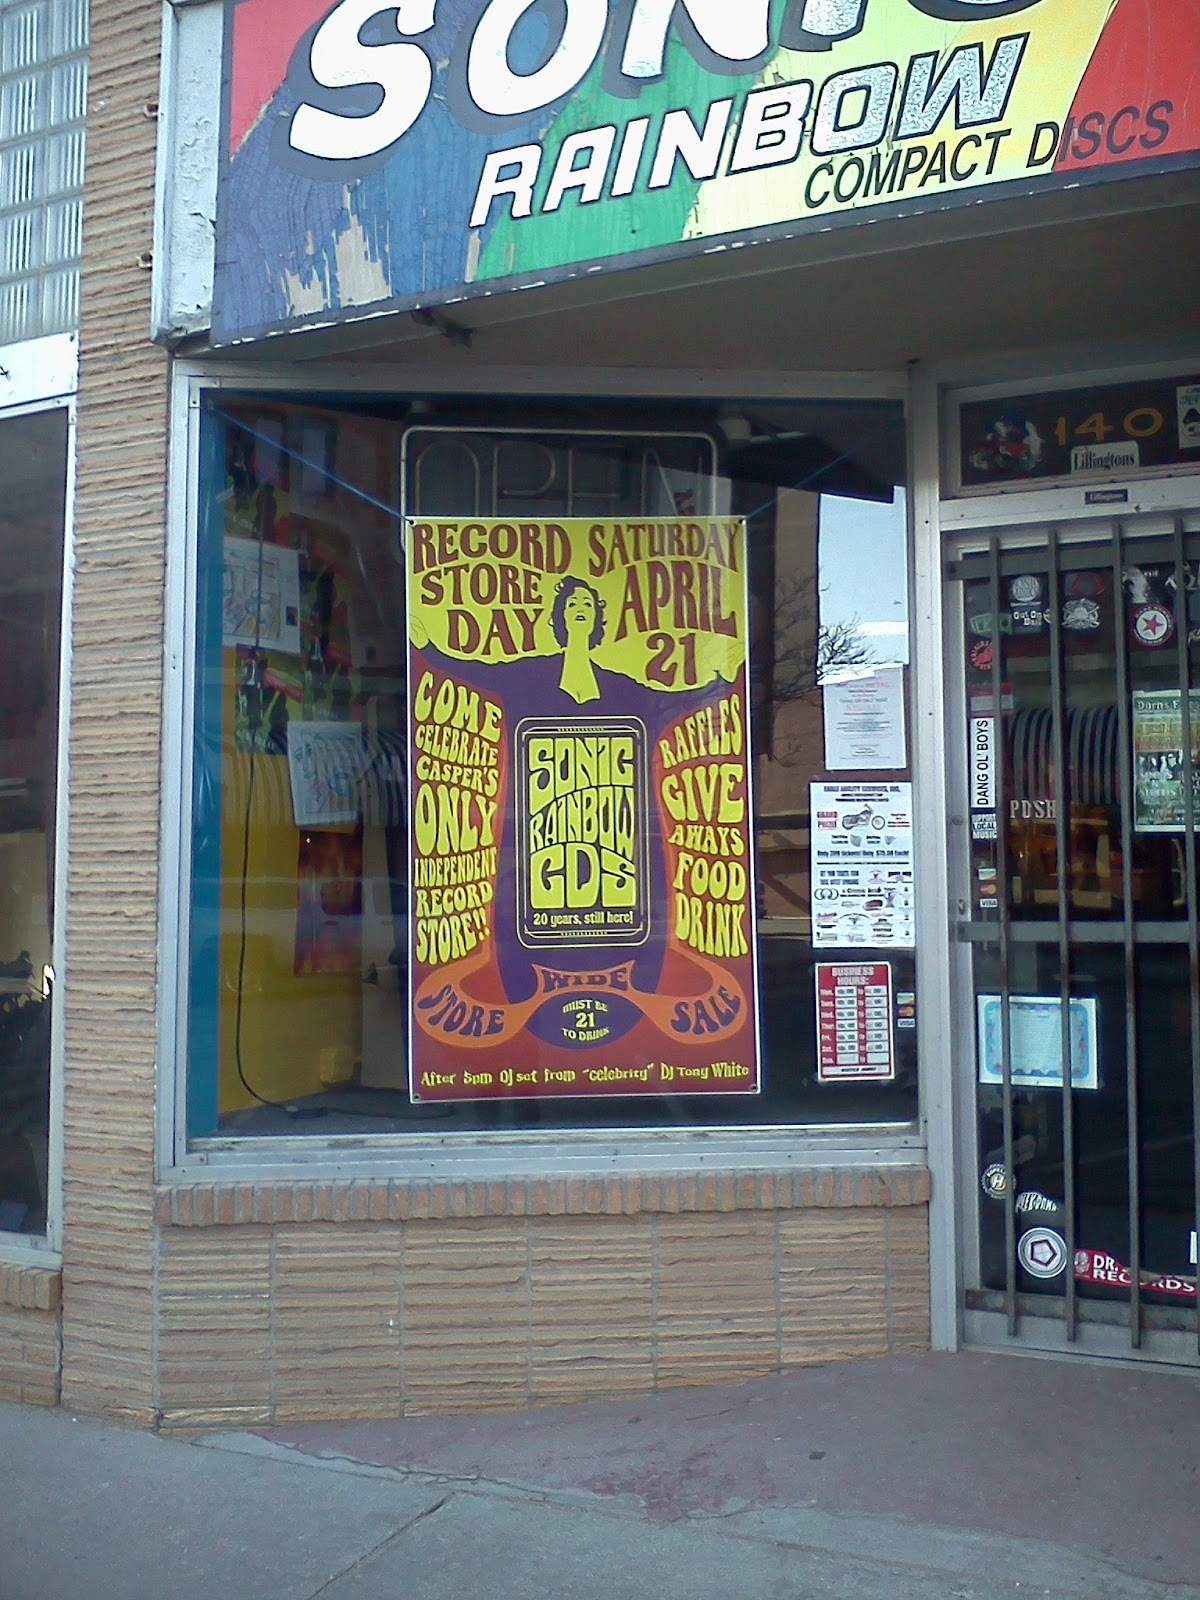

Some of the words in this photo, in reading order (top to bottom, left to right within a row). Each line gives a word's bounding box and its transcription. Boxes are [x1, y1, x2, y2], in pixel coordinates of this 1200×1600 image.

[289, 0, 970, 160] SON
[470, 32, 1030, 228] RAINBOW
[804, 128, 1011, 210] COMPACT
[1026, 99, 1174, 168] DISCS
[1054, 407, 1164, 446] 140
[413, 524, 572, 575] RECORD
[588, 524, 738, 577] SATURDAY
[421, 562, 543, 606] STORE
[614, 561, 738, 643] APRIL
[447, 609, 544, 656] DAY
[646, 633, 697, 687] 21
[414, 671, 503, 743] COME
[415, 724, 498, 767] CELEBRATE
[659, 693, 741, 769] RAFFLES
[976, 720, 989, 750] BOYS
[416, 755, 498, 797] CASPER'S
[528, 737, 634, 816] SONIC
[662, 763, 744, 824] GIVE
[976, 774, 989, 806] DANG
[414, 783, 497, 856] ONLY
[529, 786, 635, 860] RAINBOW
[668, 824, 744, 857] AWAYS
[973, 822, 996, 830] LOCAL
[973, 831, 997, 840] MUSIC
[414, 846, 497, 888] INDEPENDENT
[530, 843, 636, 909] CDS
[672, 852, 746, 901] FOOD
[415, 881, 494, 918] RECORD
[533, 912, 548, 925] 20
[584, 911, 605, 925] still
[607, 910, 634, 925] here!
[416, 907, 491, 965] STORE!!
[675, 892, 748, 958] DRINK
[541, 967, 629, 993] WIDE
[417, 984, 505, 1036] STORE
[562, 999, 593, 1014] MUST
[575, 1012, 595, 1028] 21
[670, 985, 741, 1035] SALE
[561, 1027, 577, 1039] TO
[578, 1026, 610, 1041] DRINK
[421, 1071, 456, 1087] After
[516, 1070, 537, 1084] set
[544, 1068, 575, 1083] from
[660, 1063, 674, 1080] DJ
[677, 1066, 708, 1080] Tony
[711, 1061, 749, 1078] White
[1093, 1254, 1119, 1272] DR.
[1093, 1269, 1195, 1292] RECRDS
